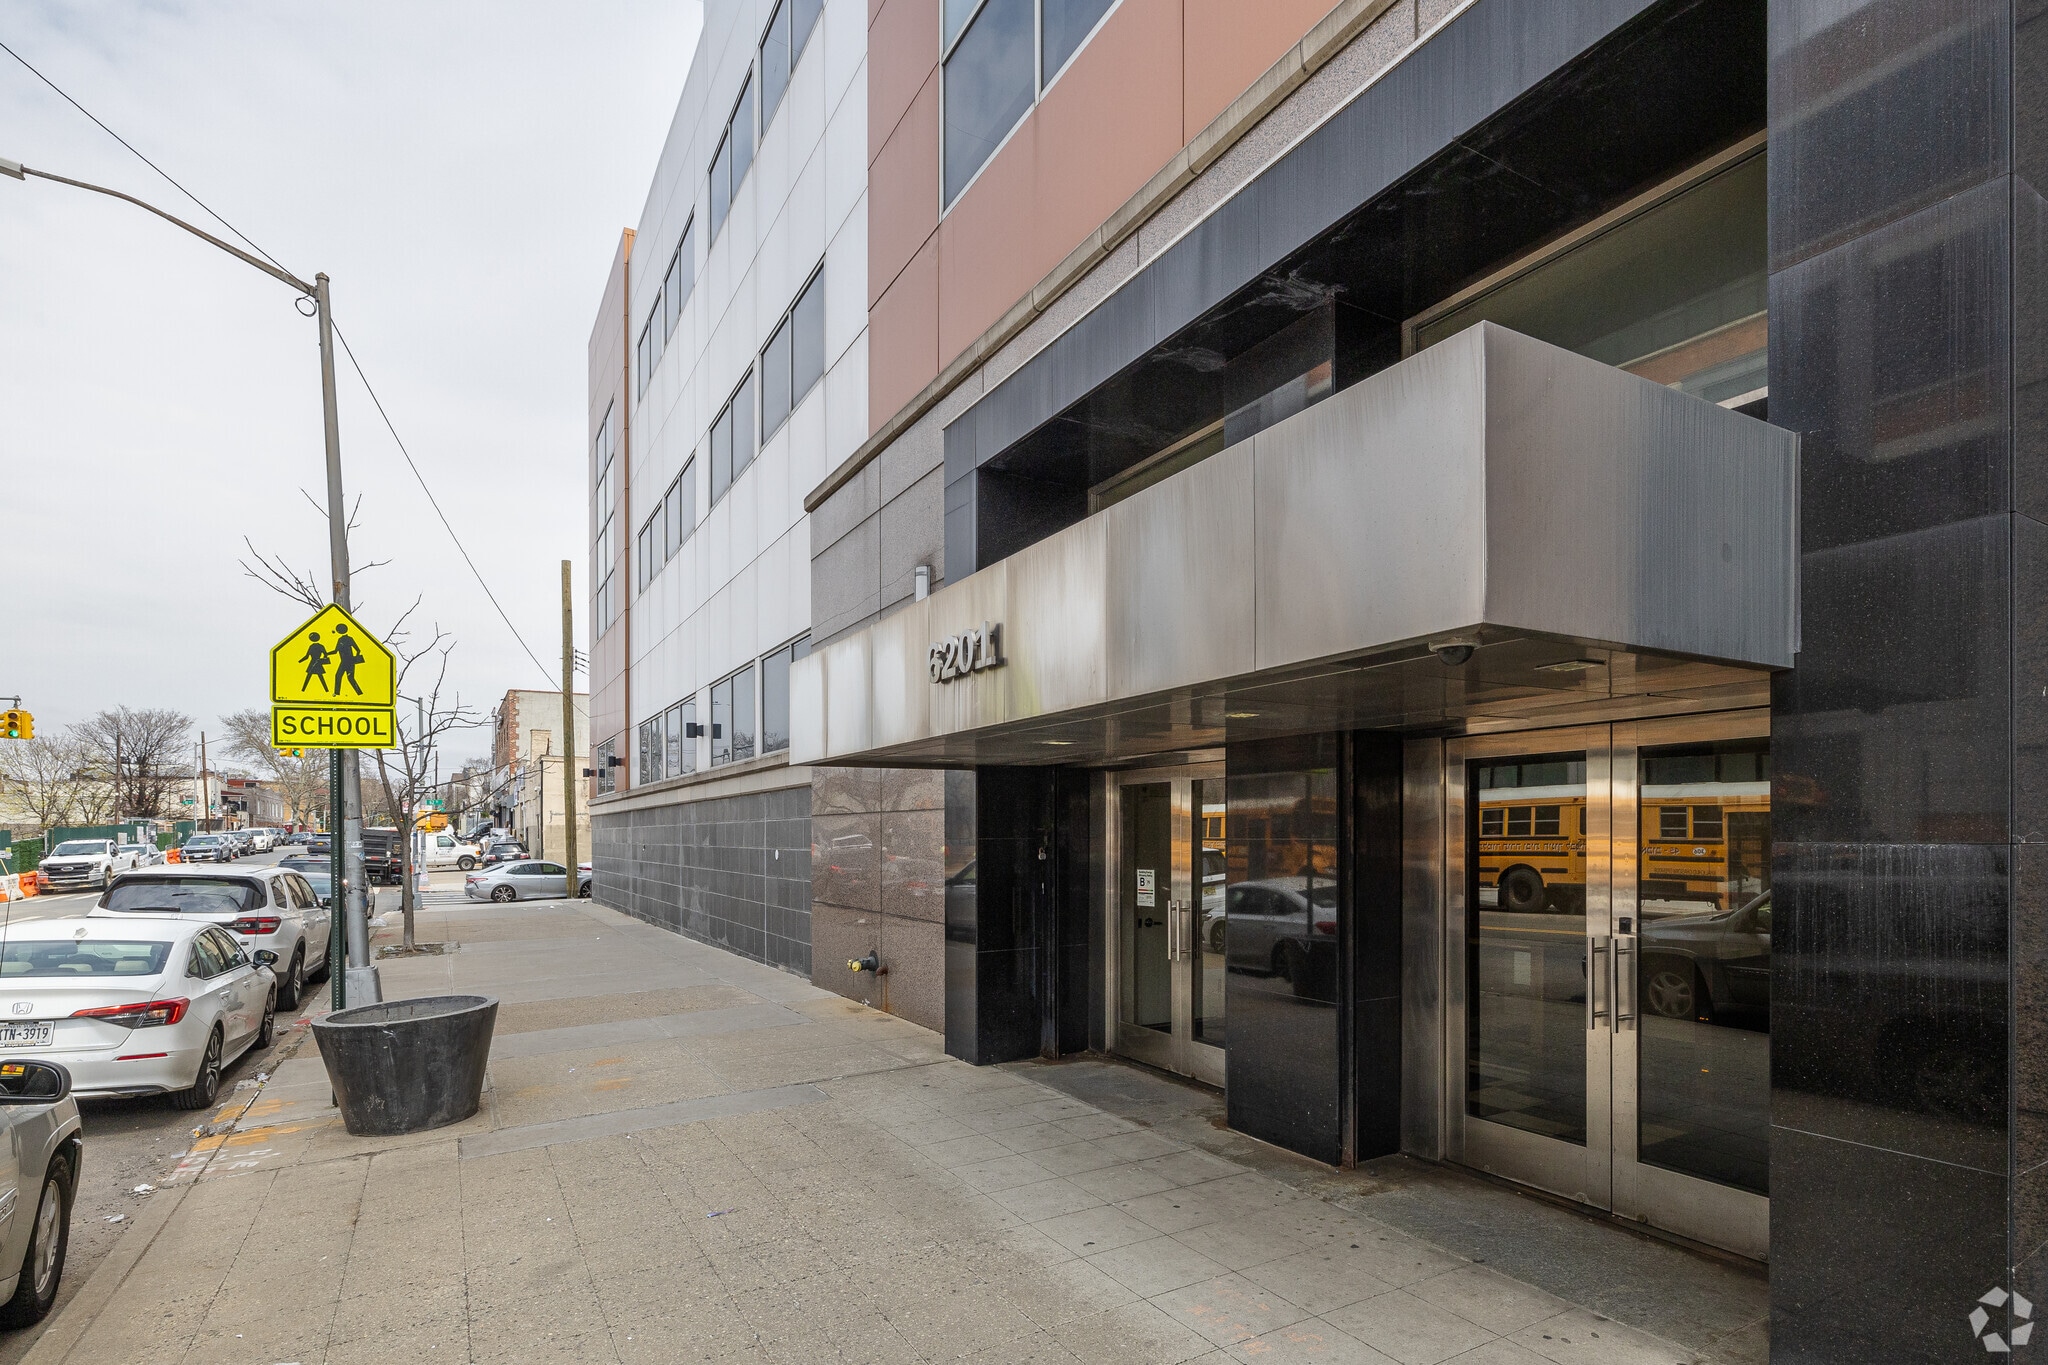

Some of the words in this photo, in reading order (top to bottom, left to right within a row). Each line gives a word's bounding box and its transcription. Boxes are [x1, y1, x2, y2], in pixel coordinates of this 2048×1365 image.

[927, 620, 997, 685] 6201
[281, 715, 387, 736] SCHOOL
[1140, 877, 1145, 887] B
[22, 1027, 49, 1040] 3919
